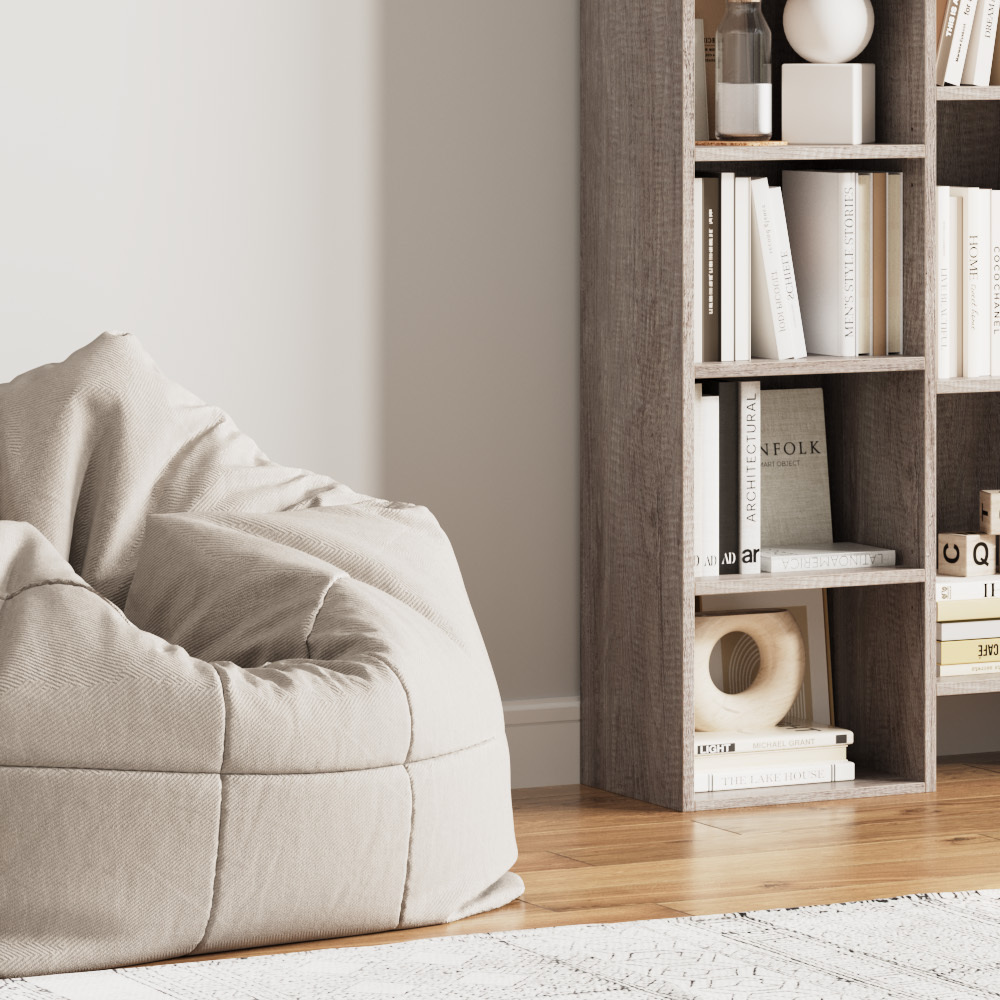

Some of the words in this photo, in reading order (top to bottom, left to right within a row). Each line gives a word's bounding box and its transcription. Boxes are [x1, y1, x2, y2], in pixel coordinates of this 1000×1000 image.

[950, 6, 958, 15] IS
[964, 3, 972, 16] for
[946, 16, 955, 37] THIS
[984, 3, 995, 38] DREAM
[844, 187, 854, 245] STORIES
[969, 235, 979, 280] HOME
[844, 248, 854, 292] STYLE
[844, 295, 854, 337] MEN'S
[746, 392, 757, 522] ARCHITECTURAL
[777, 459, 800, 467] OBJECT
[721, 552, 737, 565] AD
[742, 548, 760, 563] ar
[973, 542, 989, 566] Q
[978, 644, 999, 659] CAFÉ
[699, 744, 732, 754] LIGHT
[752, 740, 787, 749] MICHAEL
[789, 739, 815, 747] GRANT
[721, 776, 747, 786] THE
[750, 773, 778, 784] LAKE
[786, 770, 825, 782] HOUSE
